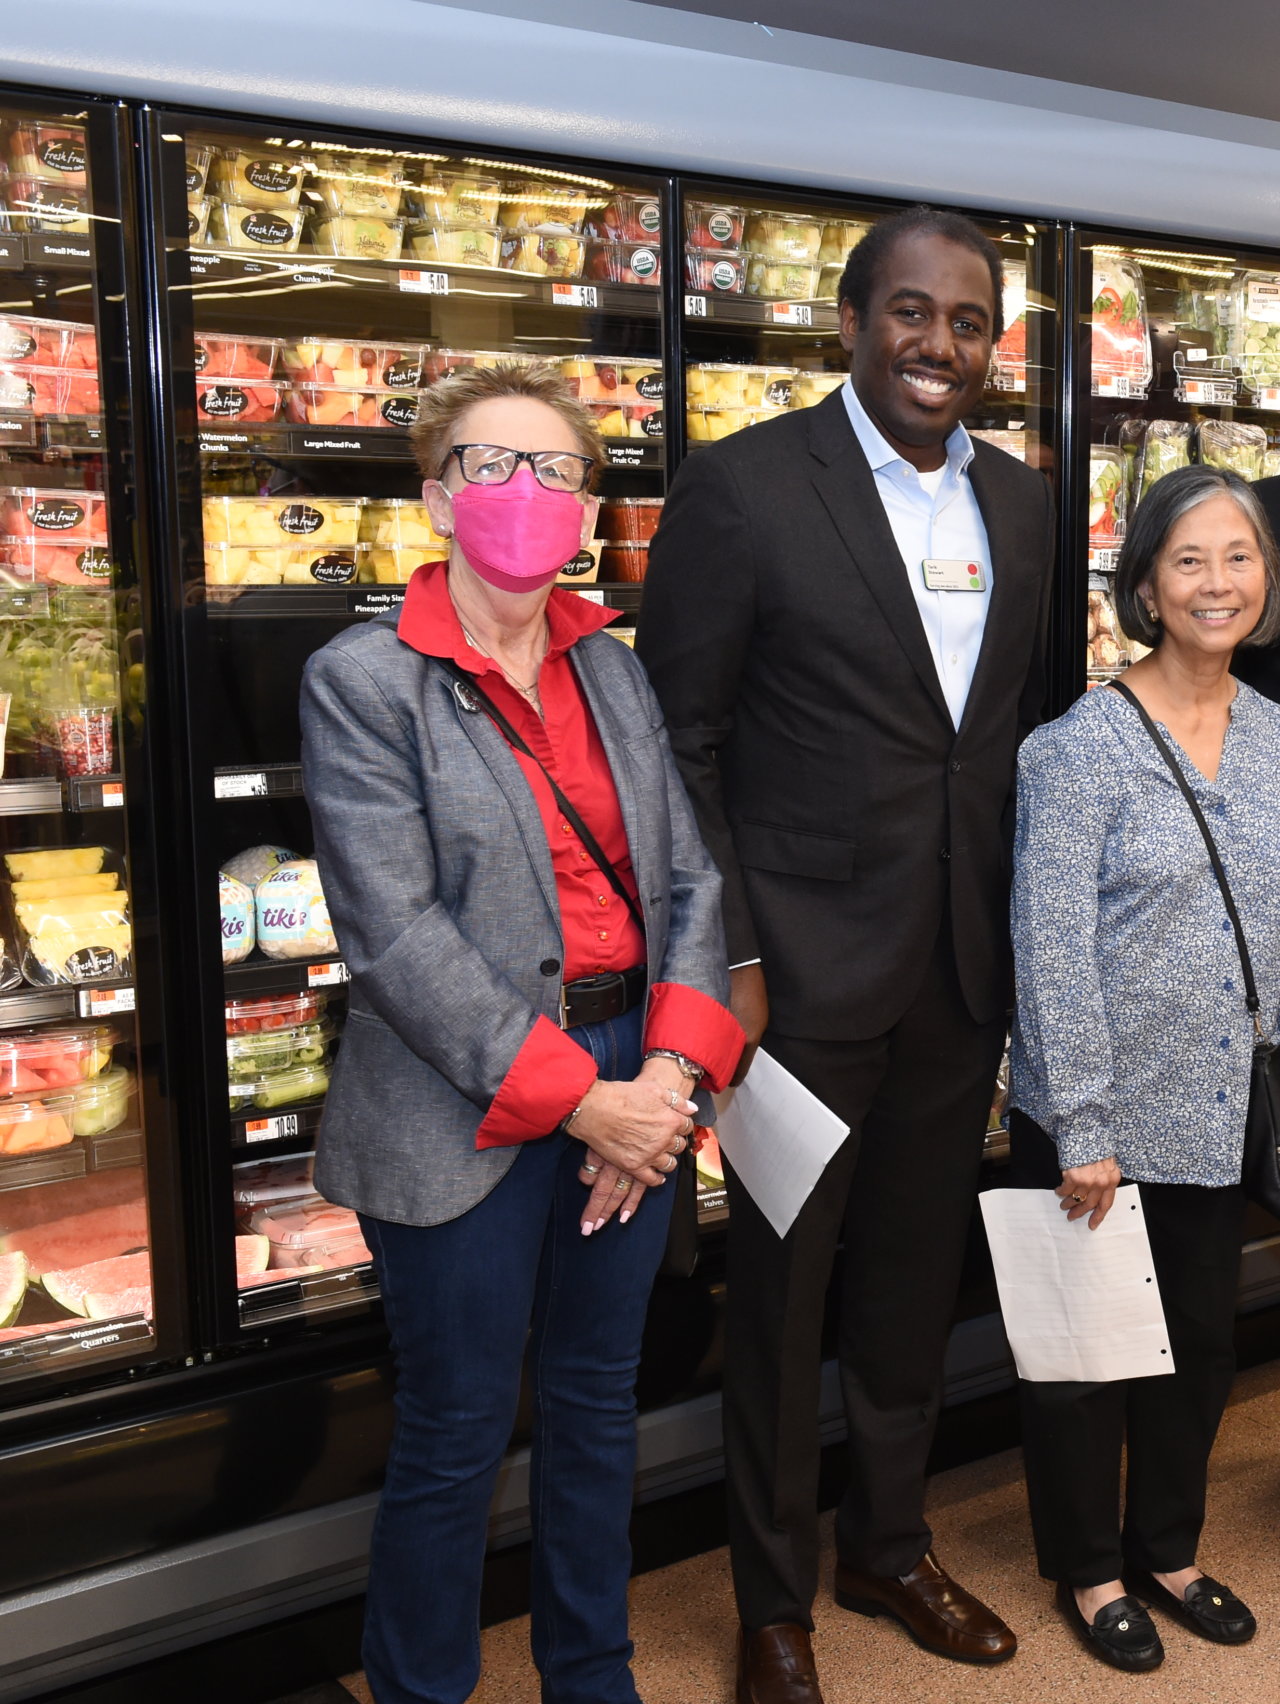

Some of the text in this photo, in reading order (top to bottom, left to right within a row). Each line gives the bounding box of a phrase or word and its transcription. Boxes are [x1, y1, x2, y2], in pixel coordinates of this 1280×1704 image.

[250, 170, 291, 185] fresh fruit
[246, 222, 288, 237] fresh fruit
[44, 246, 91, 257] Small Mixed
[189, 255, 221, 265] neapple
[293, 274, 321, 283] Chunks
[389, 373, 406, 385] fresh
[223, 397, 242, 408] fruit
[386, 406, 404, 418] fresh
[647, 420, 662, 431] fresh
[201, 432, 248, 443] Watermelon
[200, 443, 229, 452] Chunks
[304, 440, 361, 449] Large Mixed Fruit
[608, 447, 644, 457] Large Mixed
[612, 456, 640, 466] Fruit Cup
[34, 510, 78, 522] fresh fruit
[282, 515, 319, 527] fresh fruit
[314, 564, 352, 576] fresh fruit
[367, 594, 405, 604] Family Size
[355, 604, 390, 614] Pineapple
[268, 871, 302, 883] tikis
[262, 907, 307, 929] tikis
[220, 916, 245, 938] kis
[93, 955, 114, 968] fruit
[703, 1199, 724, 1208] Halves
[70, 1322, 124, 1339] Watermelon
[80, 1333, 120, 1349] Quarters
